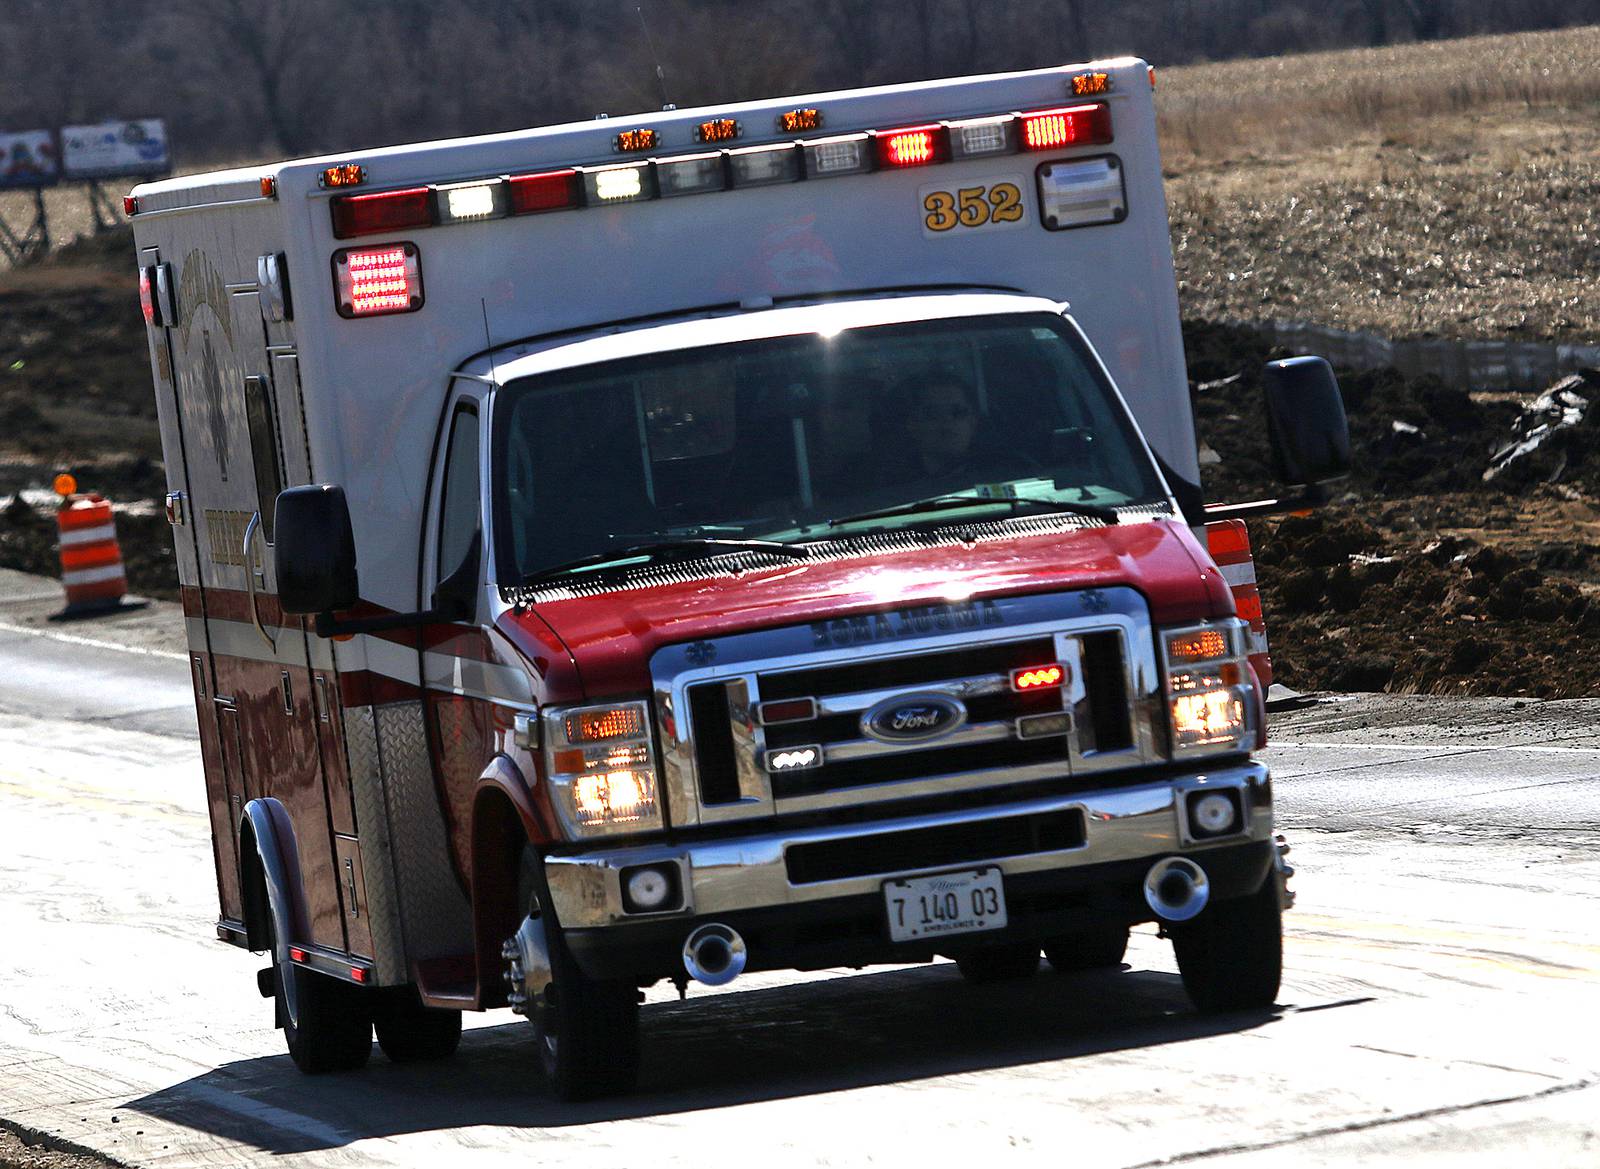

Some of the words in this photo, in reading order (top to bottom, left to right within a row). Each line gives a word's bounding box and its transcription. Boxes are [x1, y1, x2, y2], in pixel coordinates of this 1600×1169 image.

[924, 182, 1024, 232] 352
[891, 707, 939, 730] Ford
[892, 898, 905, 927] 7
[920, 892, 959, 924] 140
[971, 887, 999, 916] 03
